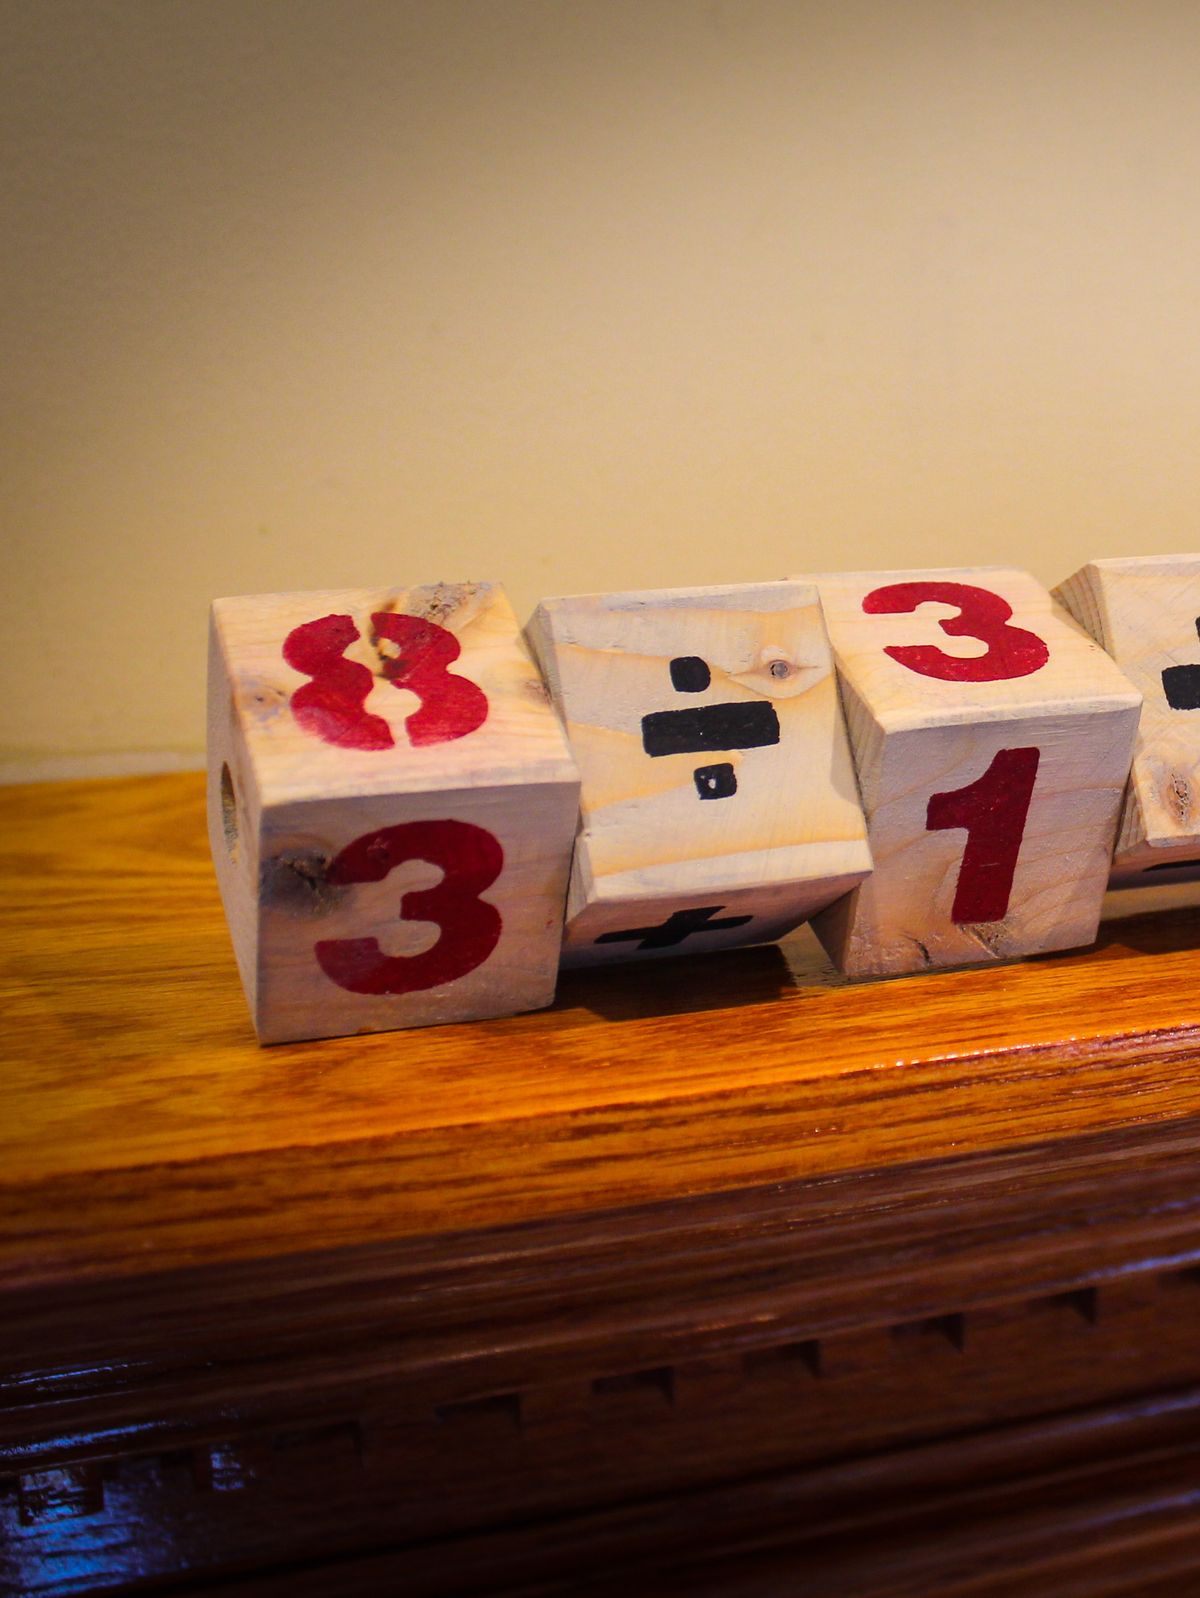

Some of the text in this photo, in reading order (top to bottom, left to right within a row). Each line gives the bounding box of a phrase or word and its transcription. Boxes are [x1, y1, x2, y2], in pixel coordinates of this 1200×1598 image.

[282, 611, 490, 752] 8
[861, 580, 1051, 684] 3
[313, 818, 506, 997] 3
[925, 746, 1041, 926] 1
